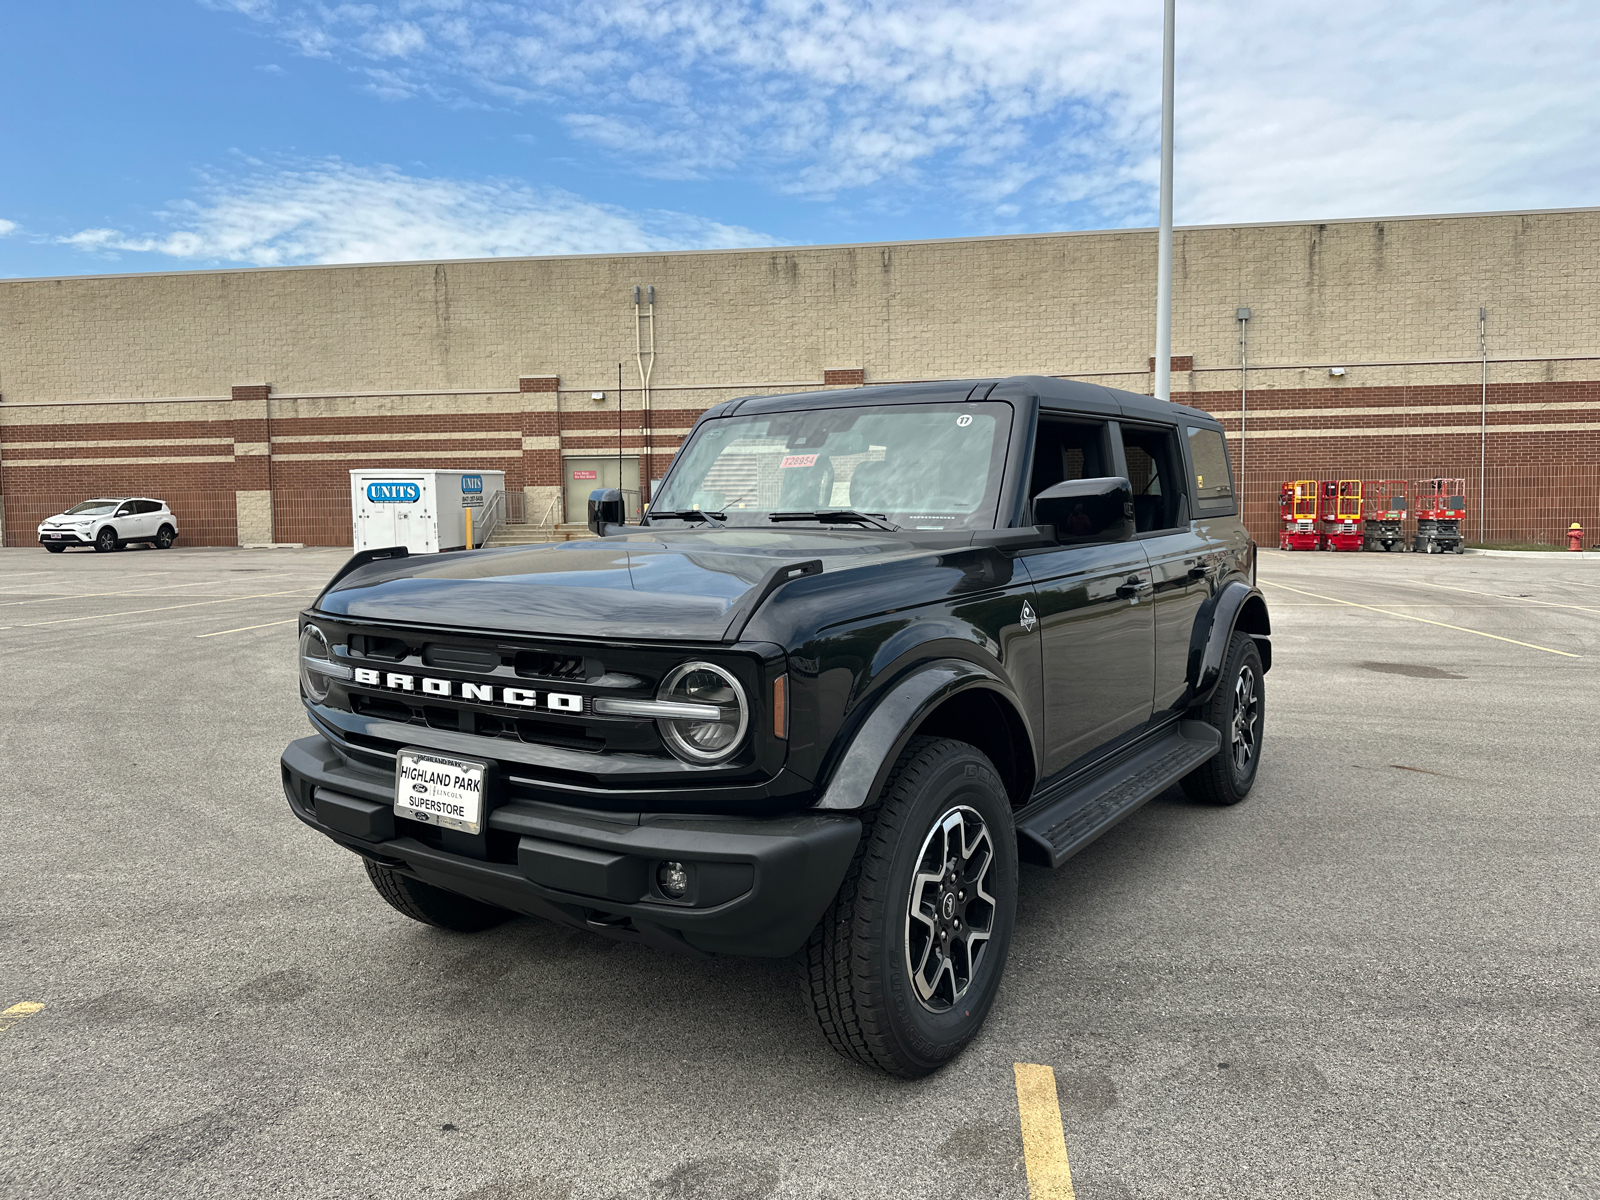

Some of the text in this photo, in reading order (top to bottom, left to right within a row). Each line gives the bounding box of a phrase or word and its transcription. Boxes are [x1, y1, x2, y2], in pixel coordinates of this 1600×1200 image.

[960, 416, 970, 425] 17
[462, 477, 481, 489] UNITS
[370, 485, 416, 498] UNITS
[354, 667, 584, 713] BRONCO
[417, 754, 462, 767] HIGHLAND PARK
[400, 765, 480, 793] HIGHLAND PARK
[436, 788, 463, 800] LINCOLN
[408, 795, 465, 817] SUPERSTORE
